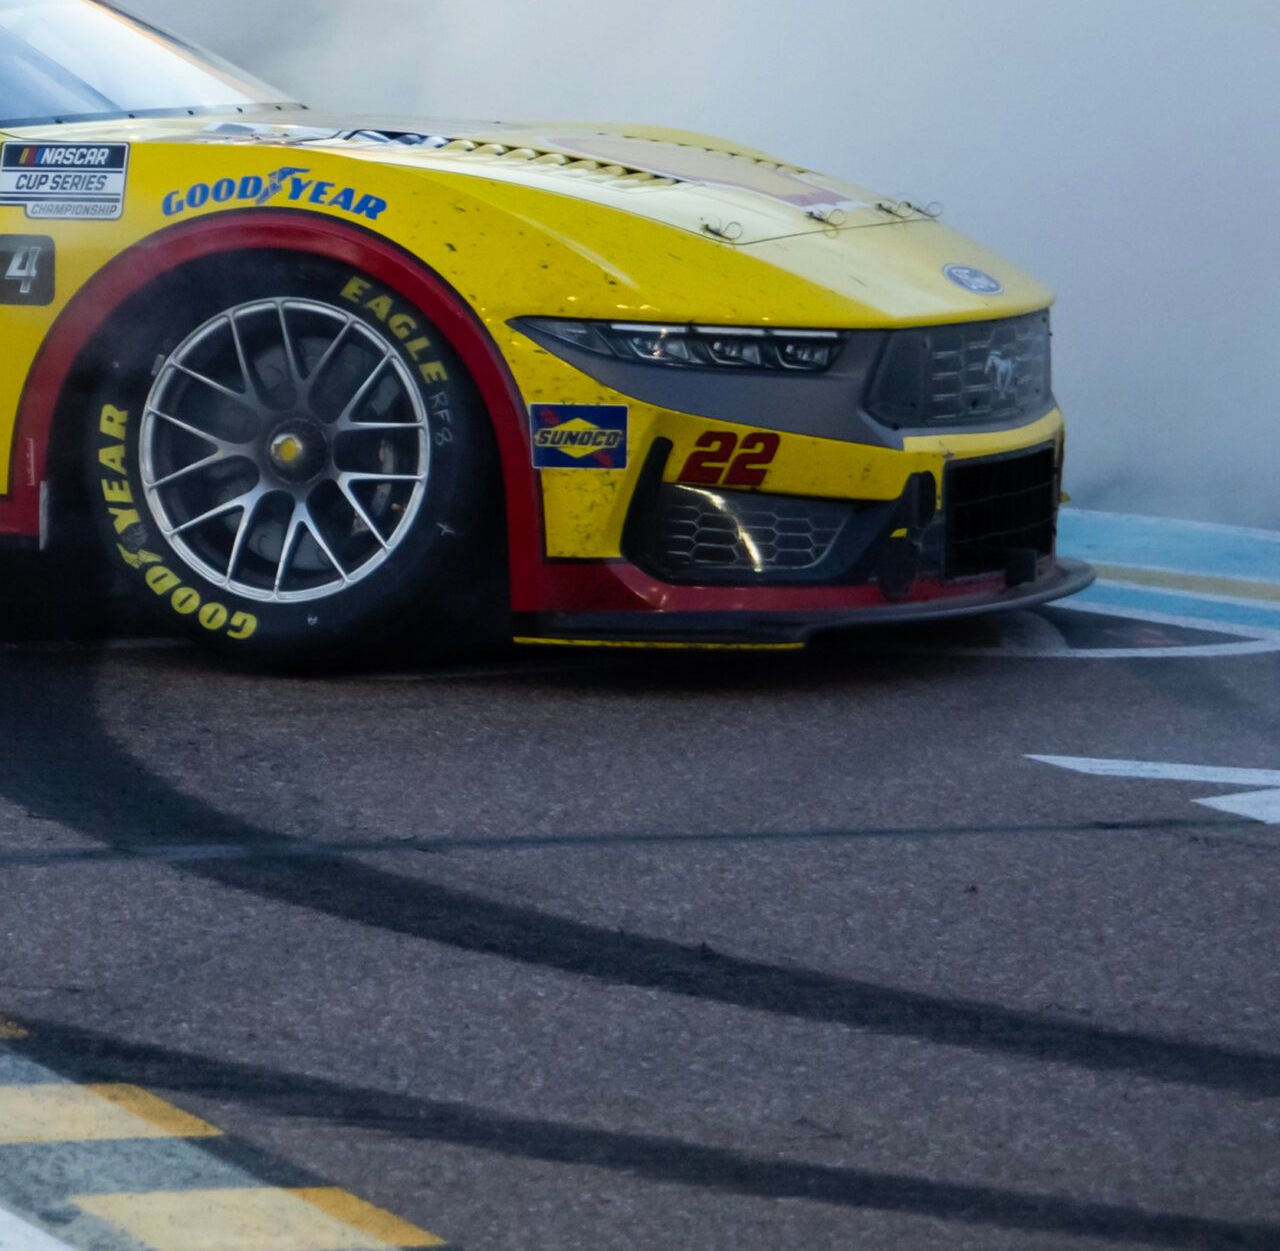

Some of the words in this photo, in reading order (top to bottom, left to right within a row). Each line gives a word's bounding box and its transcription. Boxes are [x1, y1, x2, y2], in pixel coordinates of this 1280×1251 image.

[40, 147, 109, 165] NASCAR
[15, 174, 50, 191] CUP
[50, 174, 108, 191] SERIES
[161, 169, 388, 221] GOODYEAR
[30, 203, 118, 217] CHAMPIONSHIP
[4, 246, 42, 294] 4
[340, 275, 449, 385] EAGLE
[536, 429, 621, 447] SUNOCO
[677, 430, 781, 487] 22
[97, 403, 258, 640] GOODYEAR
